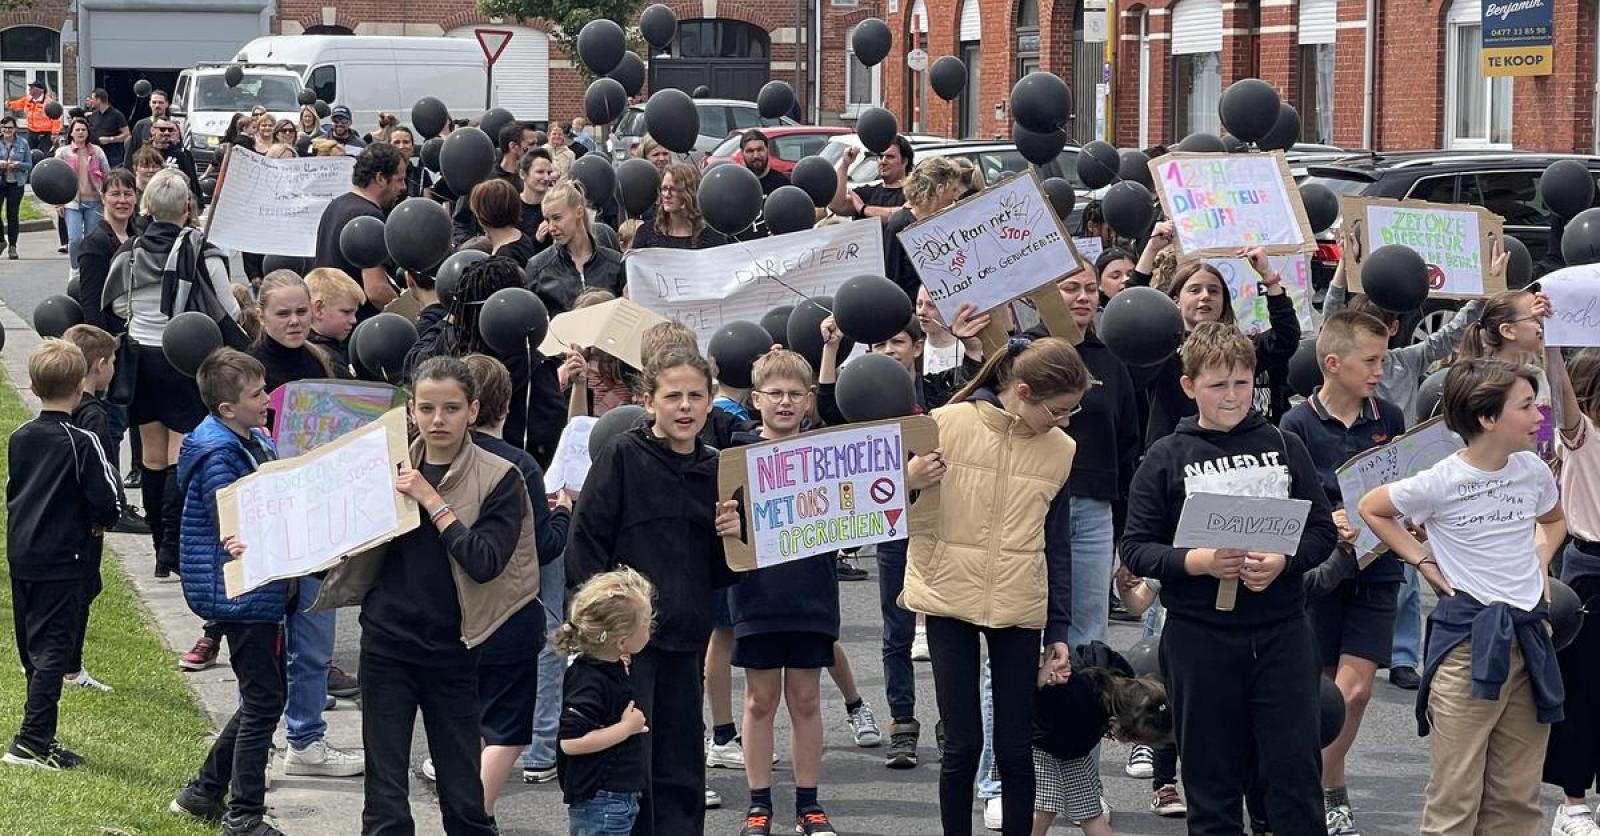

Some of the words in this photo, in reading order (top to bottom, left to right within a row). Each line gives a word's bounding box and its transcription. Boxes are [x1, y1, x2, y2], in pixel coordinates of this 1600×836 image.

[1488, 56, 1502, 67] TE
[1504, 55, 1544, 66] KOOP
[1000, 226, 1030, 240] STOP
[655, 273, 691, 297] DE
[735, 243, 860, 285] DIRECTEUR
[949, 250, 967, 276] STOP
[1184, 453, 1260, 477] NAILED
[1260, 451, 1280, 467] IT
[246, 496, 295, 523] GEEFT
[753, 495, 794, 531] MET
[796, 486, 830, 519] ONS
[1207, 512, 1301, 536] DAVID
